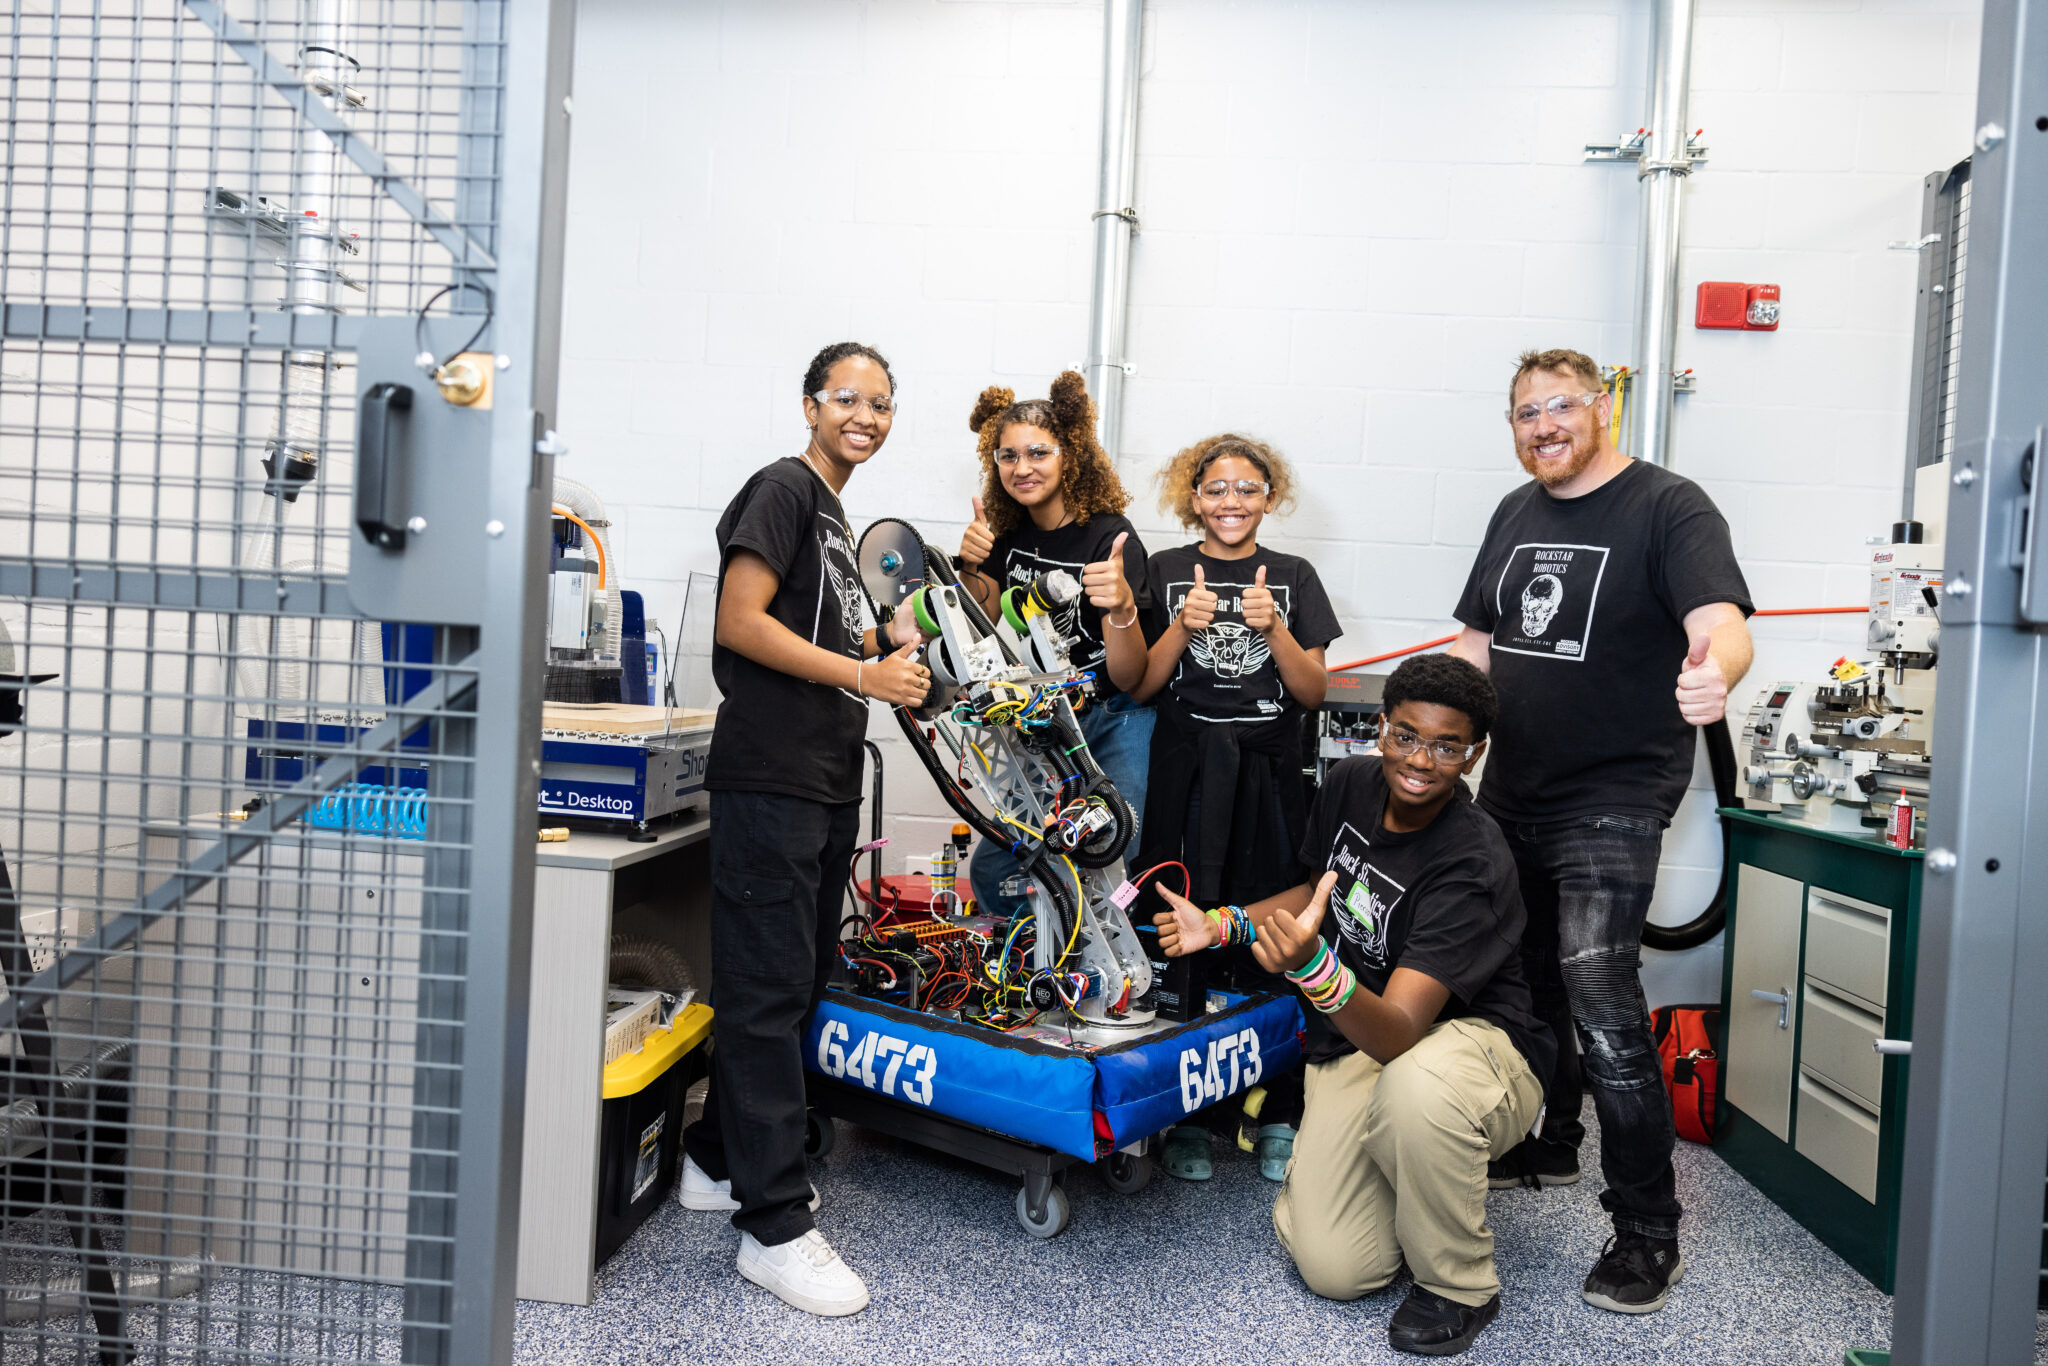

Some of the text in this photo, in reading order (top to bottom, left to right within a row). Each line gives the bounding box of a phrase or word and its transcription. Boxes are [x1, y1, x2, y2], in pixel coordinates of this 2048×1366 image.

[1534, 550, 1574, 561] ROCKSTAR
[1873, 553, 1894, 562] Grizzly
[1012, 564, 1033, 582] Rock
[1533, 563, 1568, 574] ROBOTICS
[1900, 572, 1921, 580] Grizzly
[568, 792, 633, 813] Desktop
[1339, 844, 1361, 876] Rock
[1036, 989, 1050, 999] NEO
[818, 1019, 1263, 1113] 6473 6473
